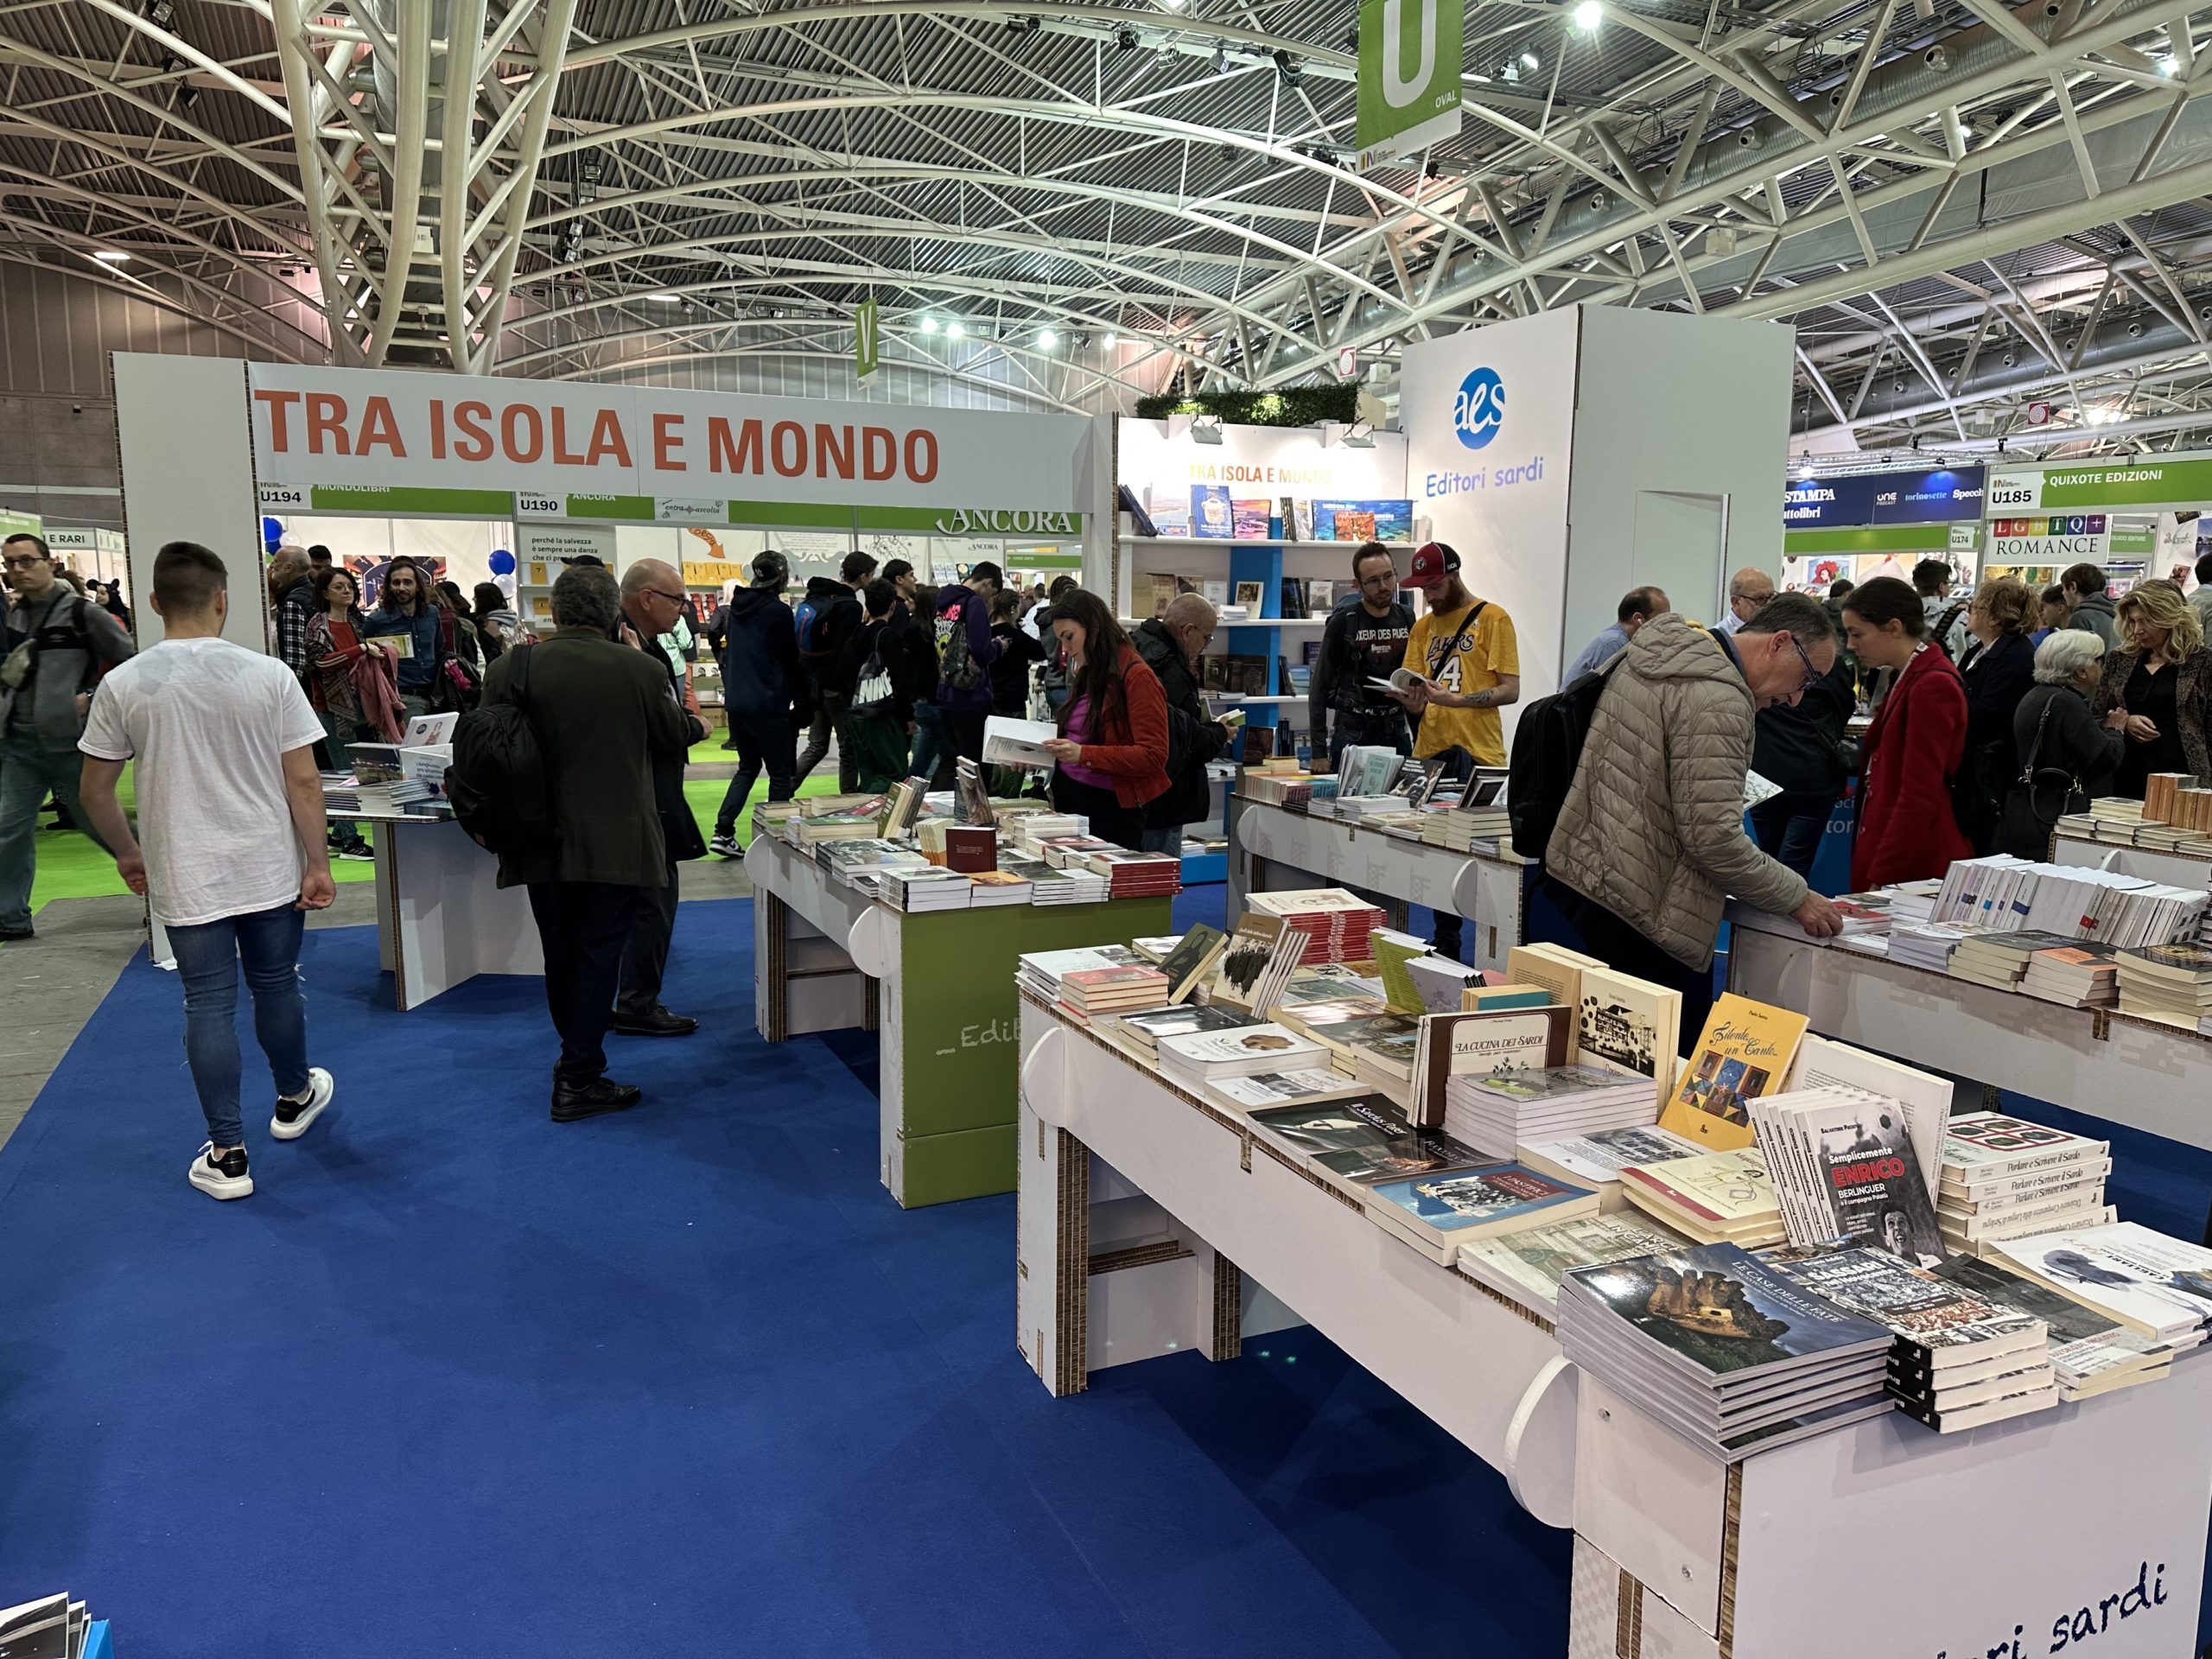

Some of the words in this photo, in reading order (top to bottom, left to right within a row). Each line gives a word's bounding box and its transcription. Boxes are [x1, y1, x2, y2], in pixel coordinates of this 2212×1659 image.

[1435, 90, 1457, 108] OVAL
[253, 390, 407, 458] TRA
[429, 399, 632, 467] ISOLA
[652, 413, 687, 472] E
[708, 416, 939, 483] MONDO
[1221, 465, 1262, 482] ISOLA
[1267, 467, 1274, 482] E
[1427, 467, 1486, 497] Editori
[1494, 456, 1544, 486] sardi
[2049, 473, 2101, 487] QUIXOTE
[2106, 469, 2163, 483] EDIZIONI
[260, 491, 302, 502] U194
[1784, 488, 1835, 503] STAMPA
[1905, 492, 1947, 501] torinosette
[1953, 487, 1984, 499] Specch
[1992, 490, 2031, 504] U185
[520, 499, 558, 512] U190
[935, 508, 1074, 535] ANCORA
[60, 534, 85, 543] RARI
[531, 537, 555, 545] perché
[1996, 537, 2098, 555] ROMANCE
[1356, 629, 1377, 641] XEUR
[1377, 628, 1391, 639] DES
[1454, 1043, 1468, 1052] LA
[1470, 1038, 1500, 1051] CUCINA
[1501, 1038, 1516, 1047] DEI
[1517, 1034, 1544, 1046] SARDI
[1828, 1146, 1893, 1165] Semplicemente
[2007, 1160, 2028, 1173] Parlare
[2034, 1154, 2056, 1167] Scrivere
[2063, 1150, 2081, 1160] Sardo
[1830, 1157, 1905, 1188] ENRICO
[2012, 1179, 2031, 1191] Parlare
[2037, 1174, 2060, 1185] Scrivere
[2066, 1169, 2083, 1179] Sardo
[1838, 1183, 1886, 1199] BERLINGUER
[1808, 1260, 1886, 1281] SASSARI
[1732, 1261, 1748, 1270] LE
[1746, 1268, 1777, 1288] CASE
[1774, 1287, 1813, 1310] DELLE
[1811, 1306, 1843, 1323] FATE
[2049, 1560, 2168, 1655] sardi
